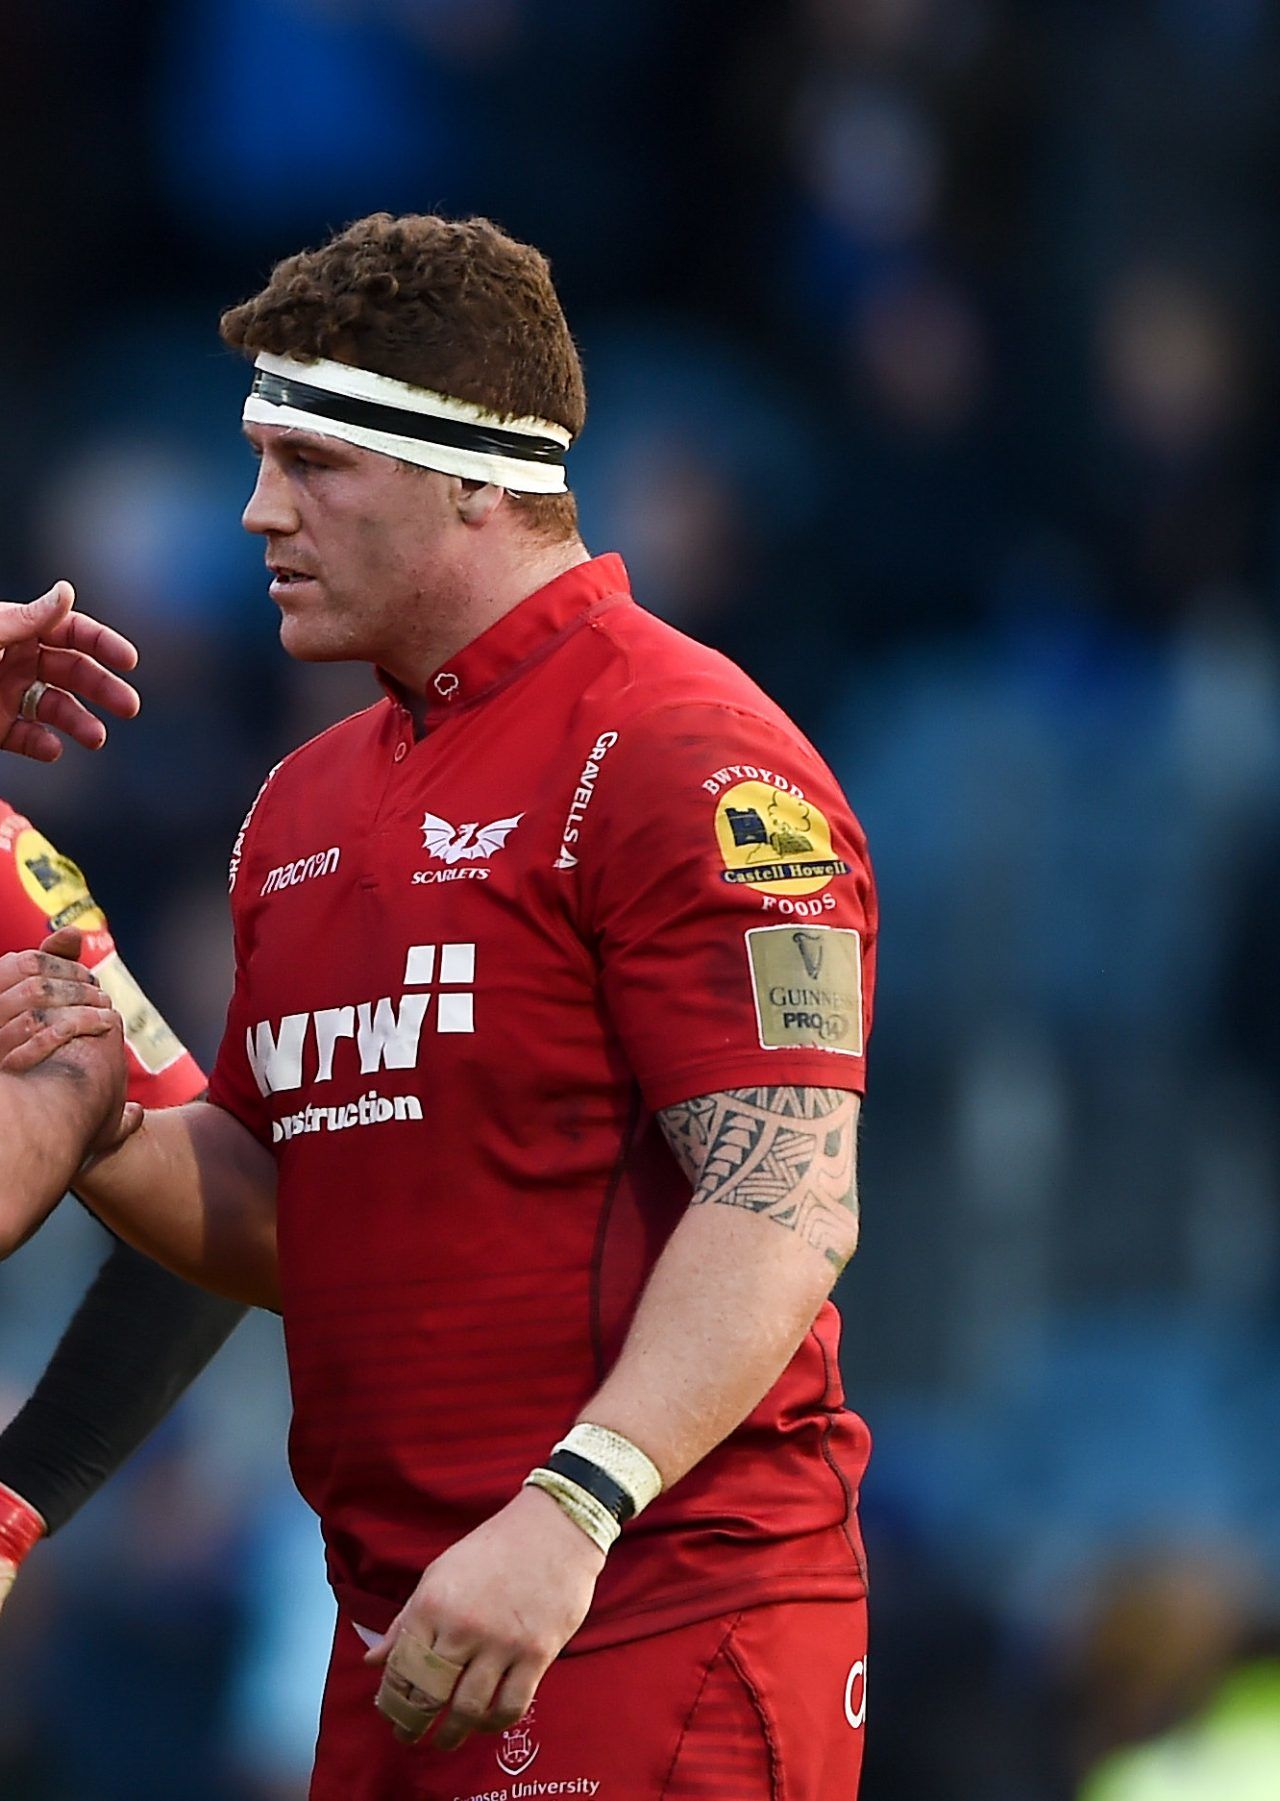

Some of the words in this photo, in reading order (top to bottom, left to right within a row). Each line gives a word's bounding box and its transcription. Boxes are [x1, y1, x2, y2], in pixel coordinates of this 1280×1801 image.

[563, 731, 618, 843] GRAVELLS
[702, 765, 804, 800] BWYDYDD
[260, 847, 340, 896] macron
[411, 867, 491, 884] SCARLETS
[724, 866, 784, 883] Castell
[789, 862, 846, 878] Howell
[762, 893, 836, 917] FOODS
[246, 992, 431, 1099] wrw
[511, 1777, 600, 1798] University
